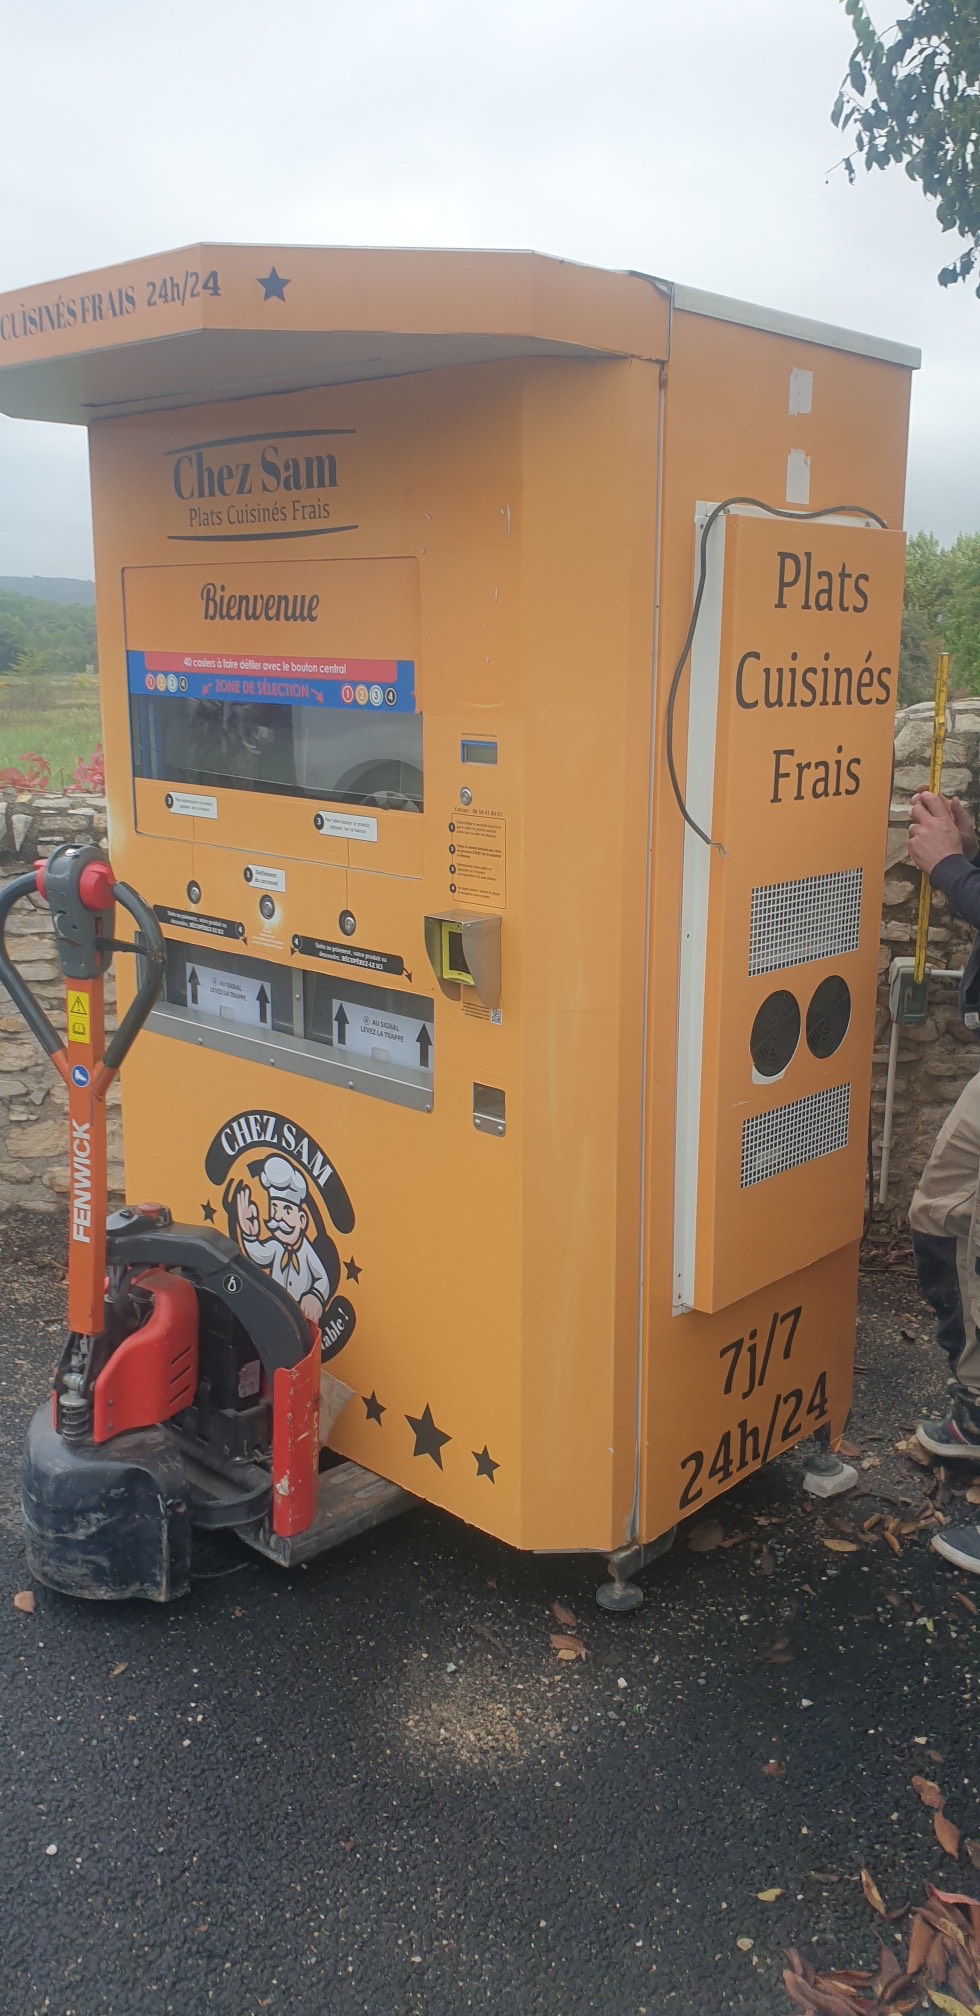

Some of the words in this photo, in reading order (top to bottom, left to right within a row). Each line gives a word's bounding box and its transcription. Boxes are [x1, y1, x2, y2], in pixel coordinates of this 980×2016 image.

[81, 285, 137, 324] FRAIS
[146, 270, 222, 307] 24h/24
[172, 451, 253, 501] Chez
[260, 445, 340, 493] Sam
[189, 507, 223, 527] Plats
[227, 500, 287, 525] Cuisinés
[291, 498, 331, 521] Frais
[201, 582, 320, 623] Bienvenue
[774, 550, 870, 614] Plats
[183, 656, 192, 667] 40
[193, 657, 216, 668] casiers
[217, 657, 222, 668] à
[222, 658, 239, 669] faire
[240, 658, 262, 670] défiler
[262, 662, 281, 671] avec
[282, 661, 290, 671] le
[291, 661, 318, 673] bouton
[320, 663, 347, 674] central
[215, 679, 240, 694] ZONE
[242, 680, 255, 695] DE
[256, 677, 310, 698] SÉLECTION
[735, 650, 892, 710] Cuisinés
[769, 744, 861, 804] Frais
[360, 1025, 376, 1036] LEVEZ
[384, 1032, 404, 1043] TRAPPE
[380, 1021, 400, 1032] SIGNAL
[220, 1114, 278, 1156] CHEZ
[281, 1122, 334, 1188] SAM
[72, 1118, 93, 1243] FENWICK
[719, 1305, 803, 1400] 7j/7
[678, 1370, 828, 1510] 24h/24
